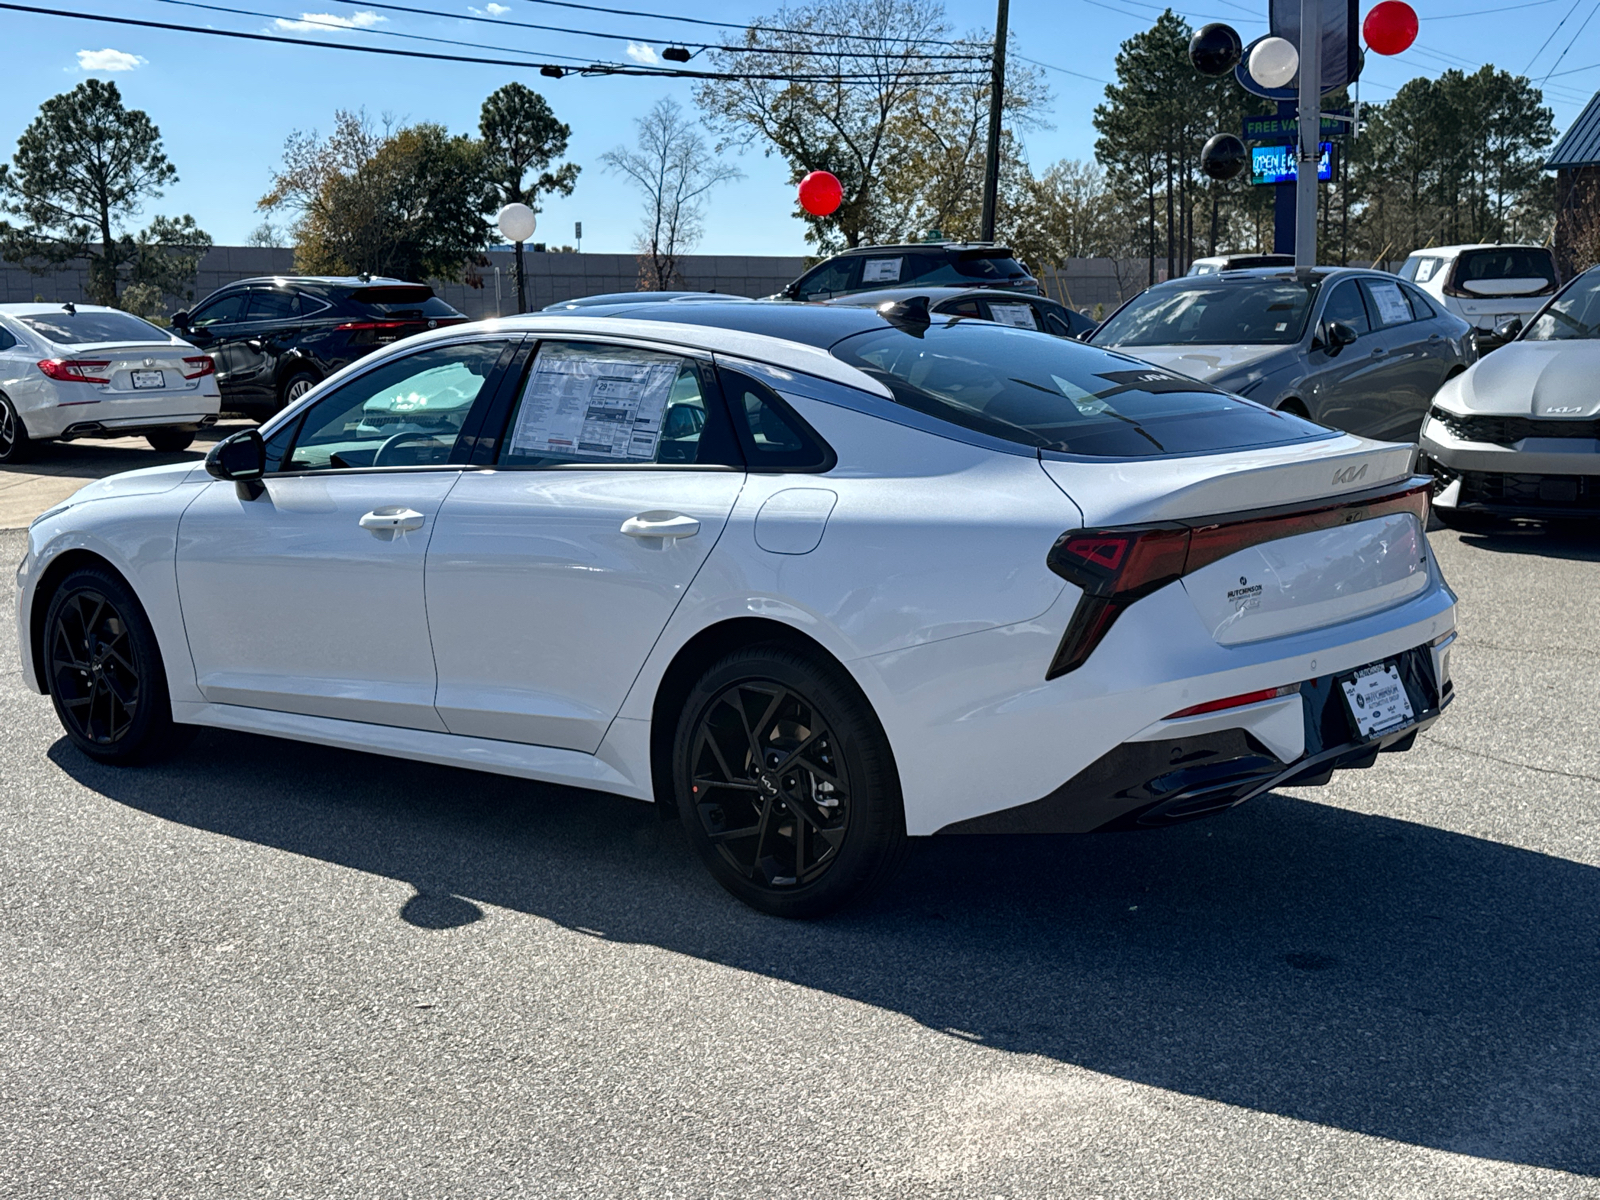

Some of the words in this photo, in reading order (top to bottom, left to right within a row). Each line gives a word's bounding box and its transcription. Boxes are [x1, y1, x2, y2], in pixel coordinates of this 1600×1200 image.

[1247, 121, 1278, 134] FREE
[1253, 154, 1278, 168] OPEN
[598, 382, 608, 391] 29
[1546, 406, 1584, 414] KIA
[1332, 463, 1369, 486] KIA
[1227, 584, 1263, 599] HUTCHINSON
[1364, 686, 1400, 704] HUTCHINSON
